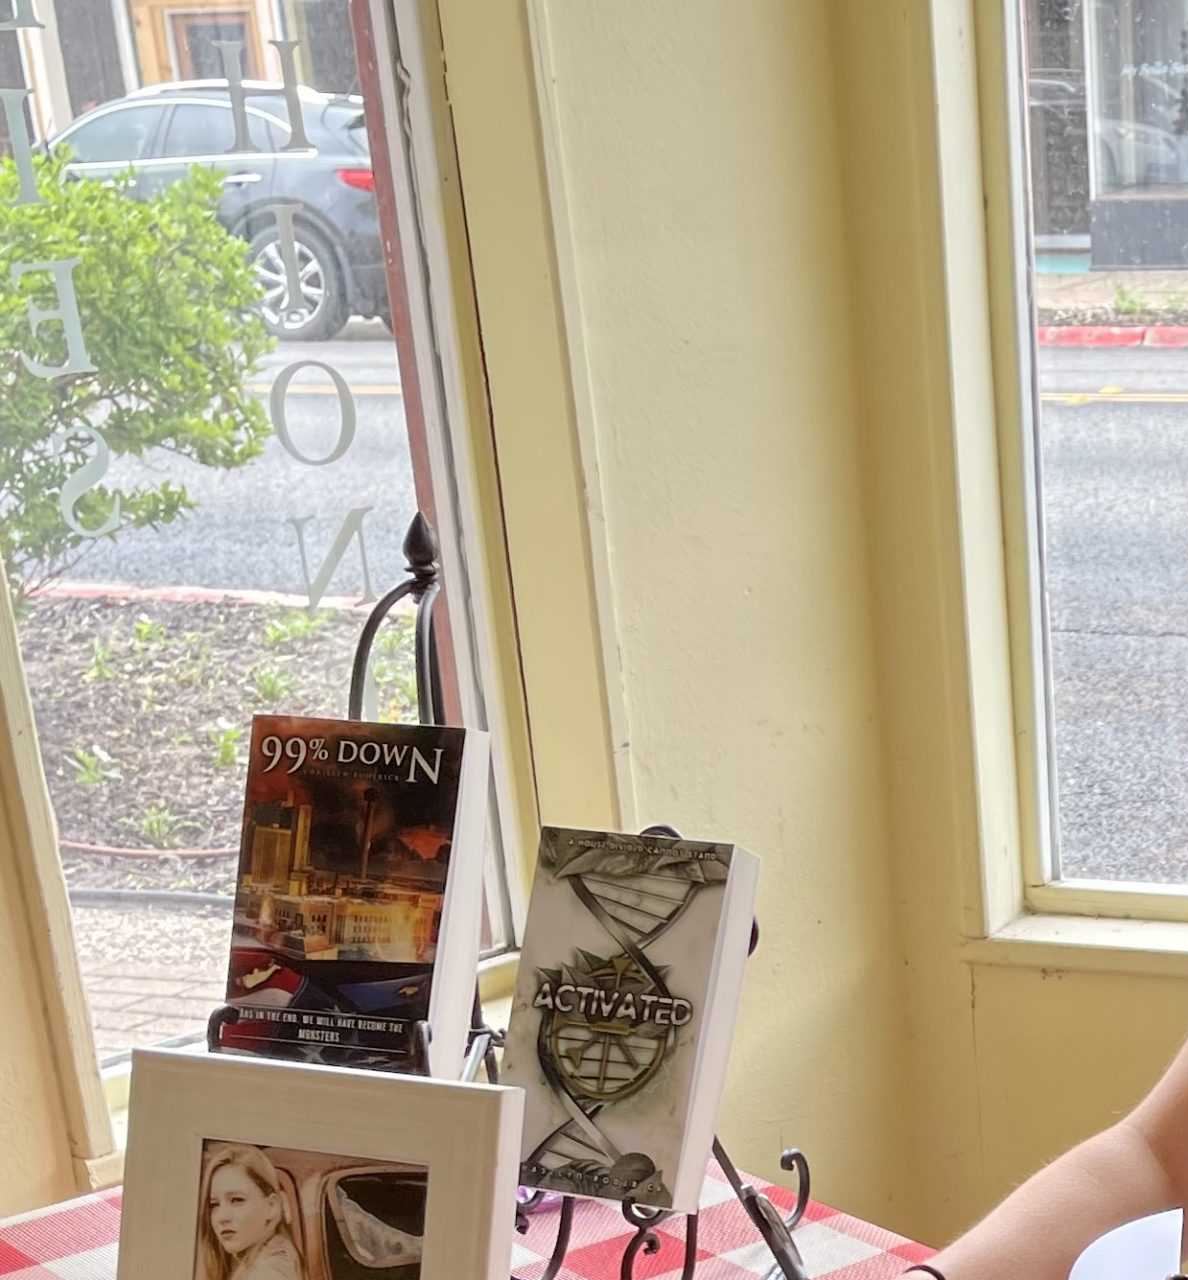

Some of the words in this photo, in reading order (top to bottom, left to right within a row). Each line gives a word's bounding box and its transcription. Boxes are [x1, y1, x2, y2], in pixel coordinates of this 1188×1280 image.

[260, 735, 329, 774] 99%
[336, 739, 445, 785] DOWN
[535, 981, 694, 1027] ACTIVATED
[297, 1028, 341, 1043] MONSTERS
[316, 1014, 335, 1027] WILL
